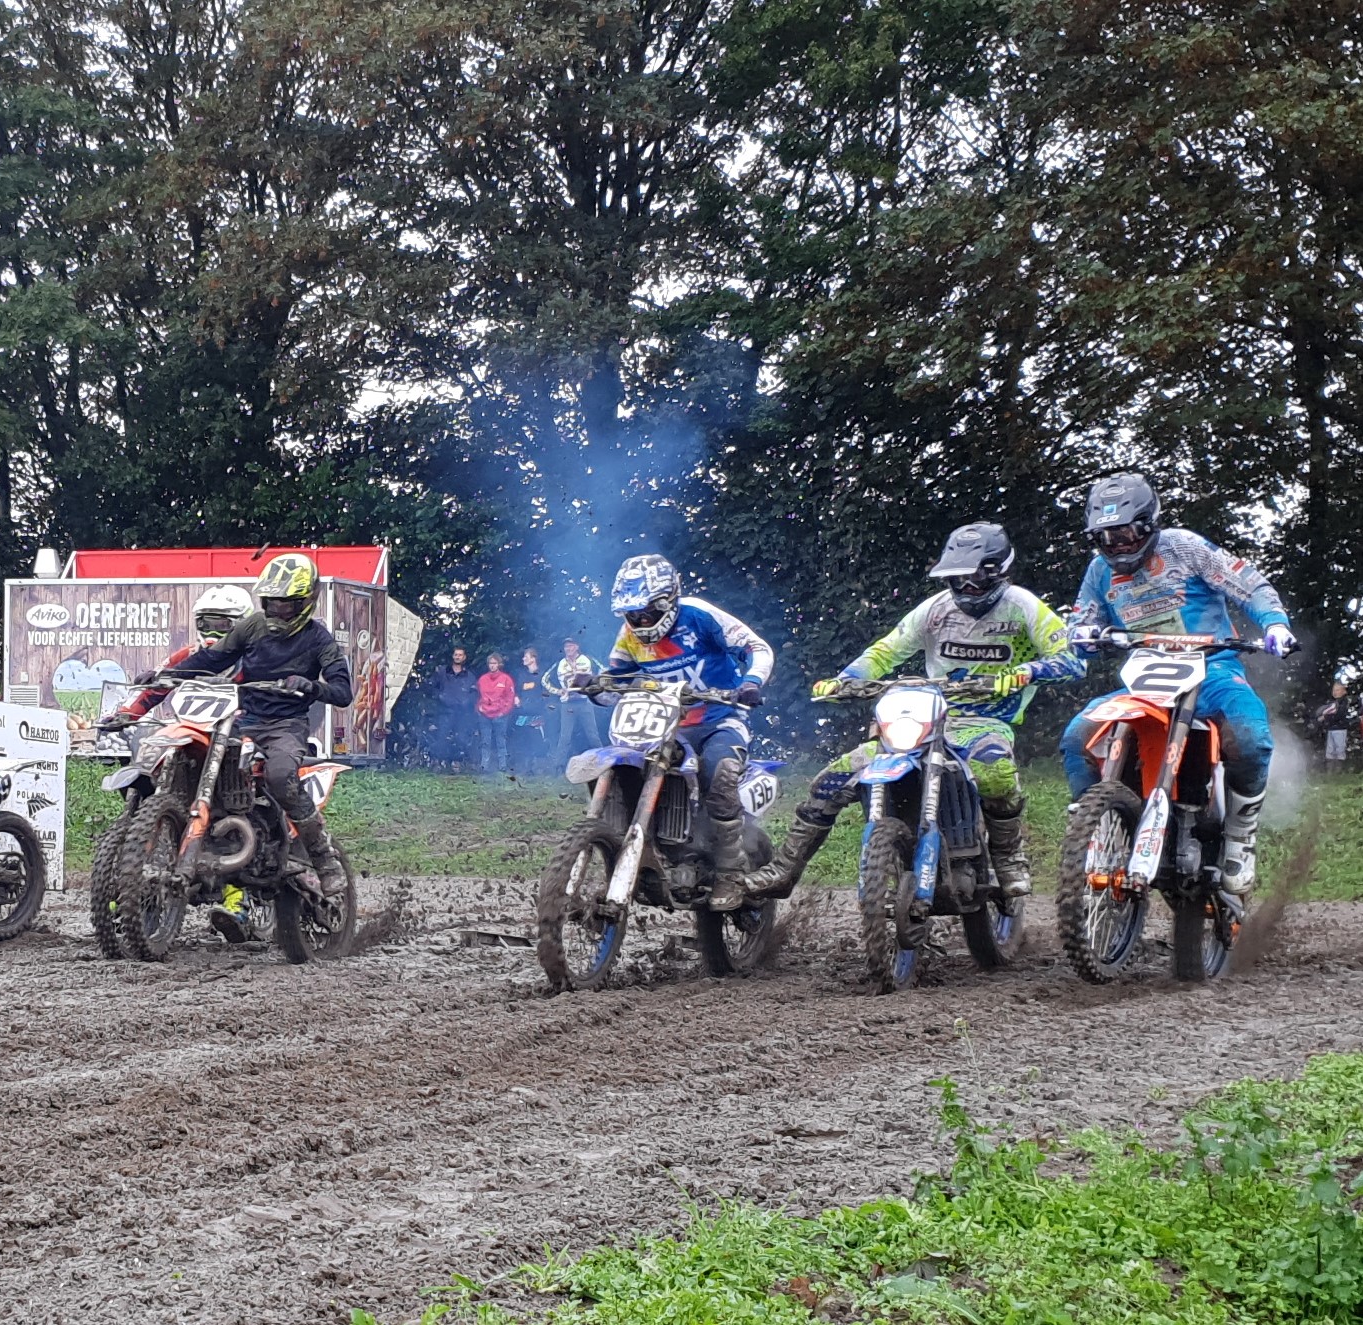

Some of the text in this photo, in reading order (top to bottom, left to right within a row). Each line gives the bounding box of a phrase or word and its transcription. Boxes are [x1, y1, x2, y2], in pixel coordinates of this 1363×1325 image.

[75, 602, 170, 628] OERFRIET
[27, 631, 170, 646] VOOR ECHTE LIEFHEBBERS
[944, 642, 1003, 660] LESONAL
[1130, 662, 1195, 693] 2
[178, 694, 232, 718] 171
[617, 702, 672, 737] 136
[748, 776, 773, 813] 136
